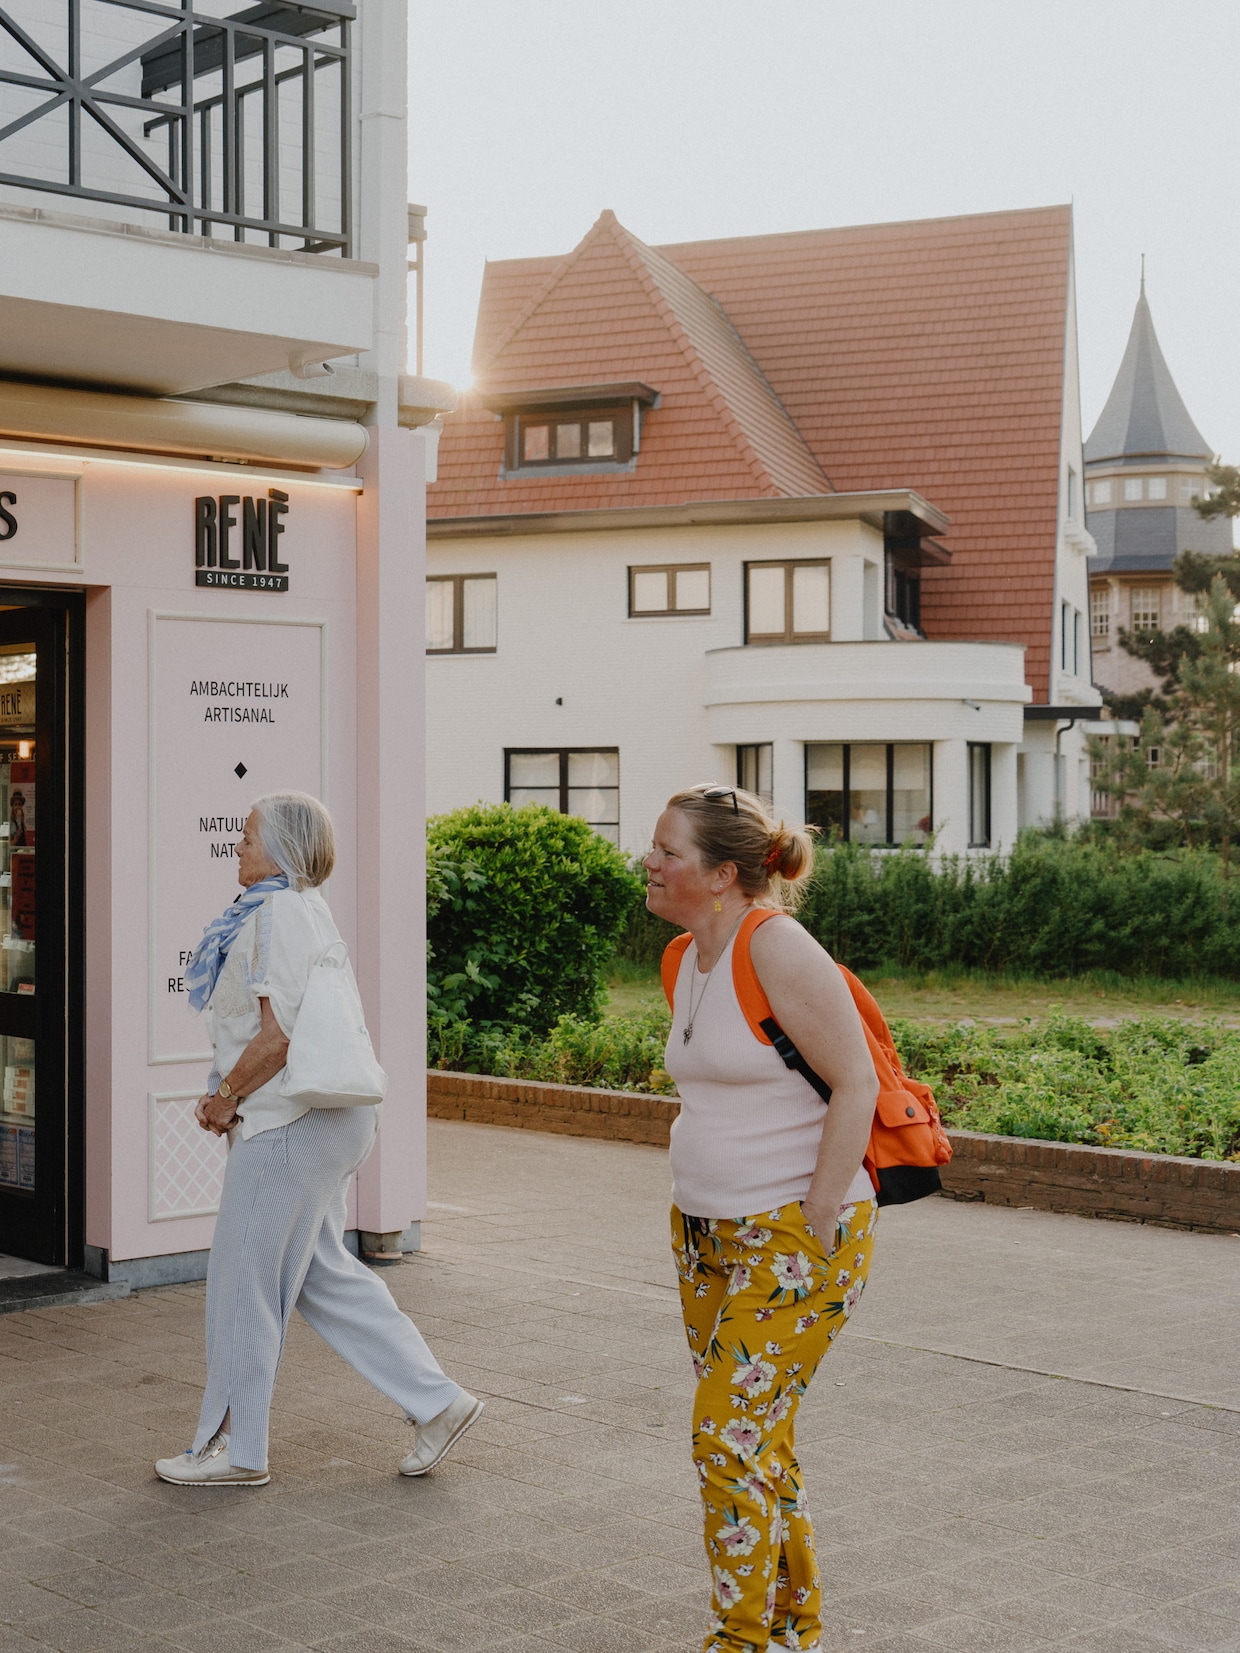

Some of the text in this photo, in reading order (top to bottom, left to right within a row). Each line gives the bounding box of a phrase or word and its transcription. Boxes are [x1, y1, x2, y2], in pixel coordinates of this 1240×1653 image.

[206, 573, 282, 588] SINCE 1947
[189, 680, 289, 698] AMBACHTELIJK
[204, 707, 276, 723] ARTISANAL
[199, 817, 247, 832] NATUU
[210, 843, 241, 858] NAT
